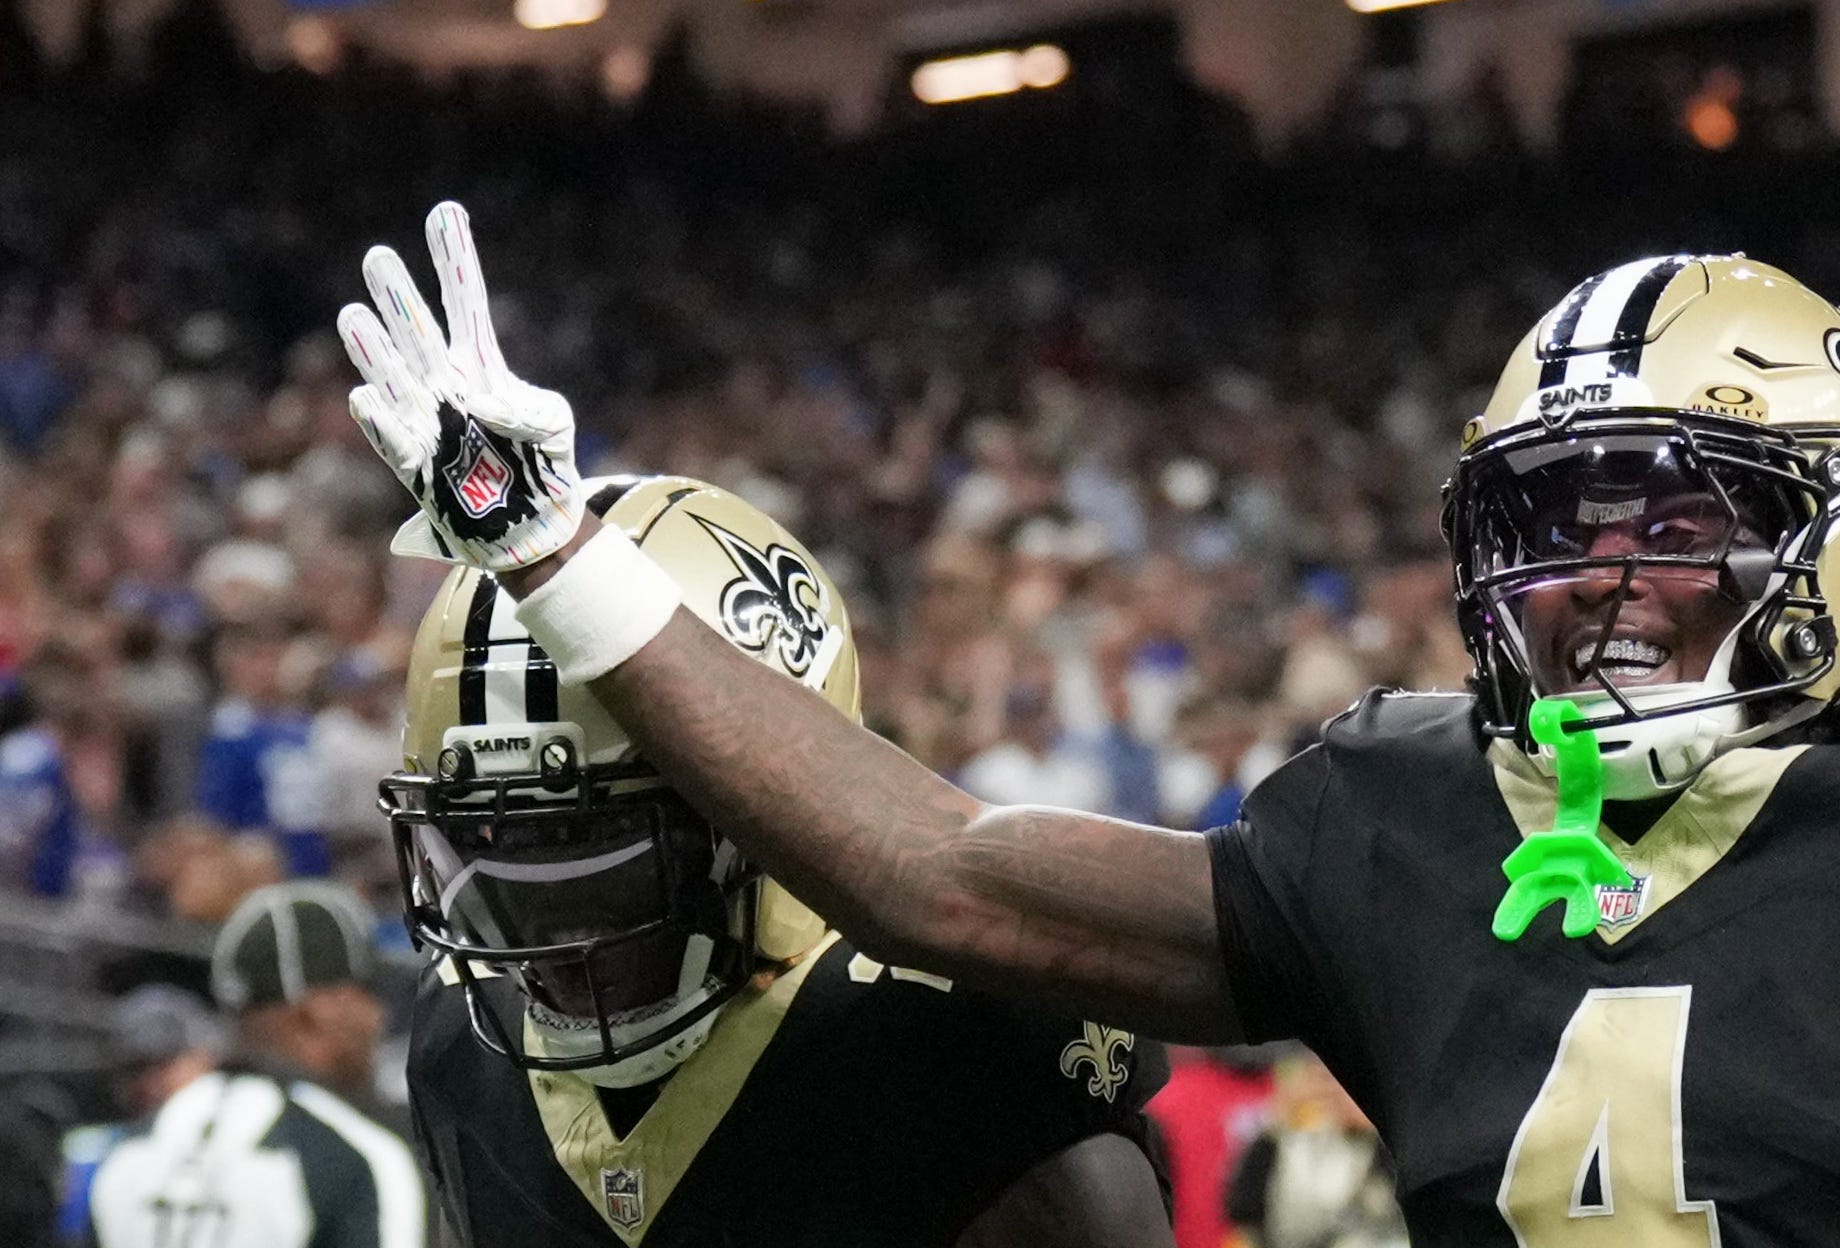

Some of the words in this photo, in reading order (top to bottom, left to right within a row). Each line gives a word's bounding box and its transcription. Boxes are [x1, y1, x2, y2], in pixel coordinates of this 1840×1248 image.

[1538, 383, 1612, 411] SAINTS
[1692, 403, 1764, 419] OAKLEY
[461, 455, 507, 510] NFL
[473, 736, 530, 753] SAINTS
[1601, 894, 1633, 919] NFL
[609, 1195, 638, 1221] NFL
